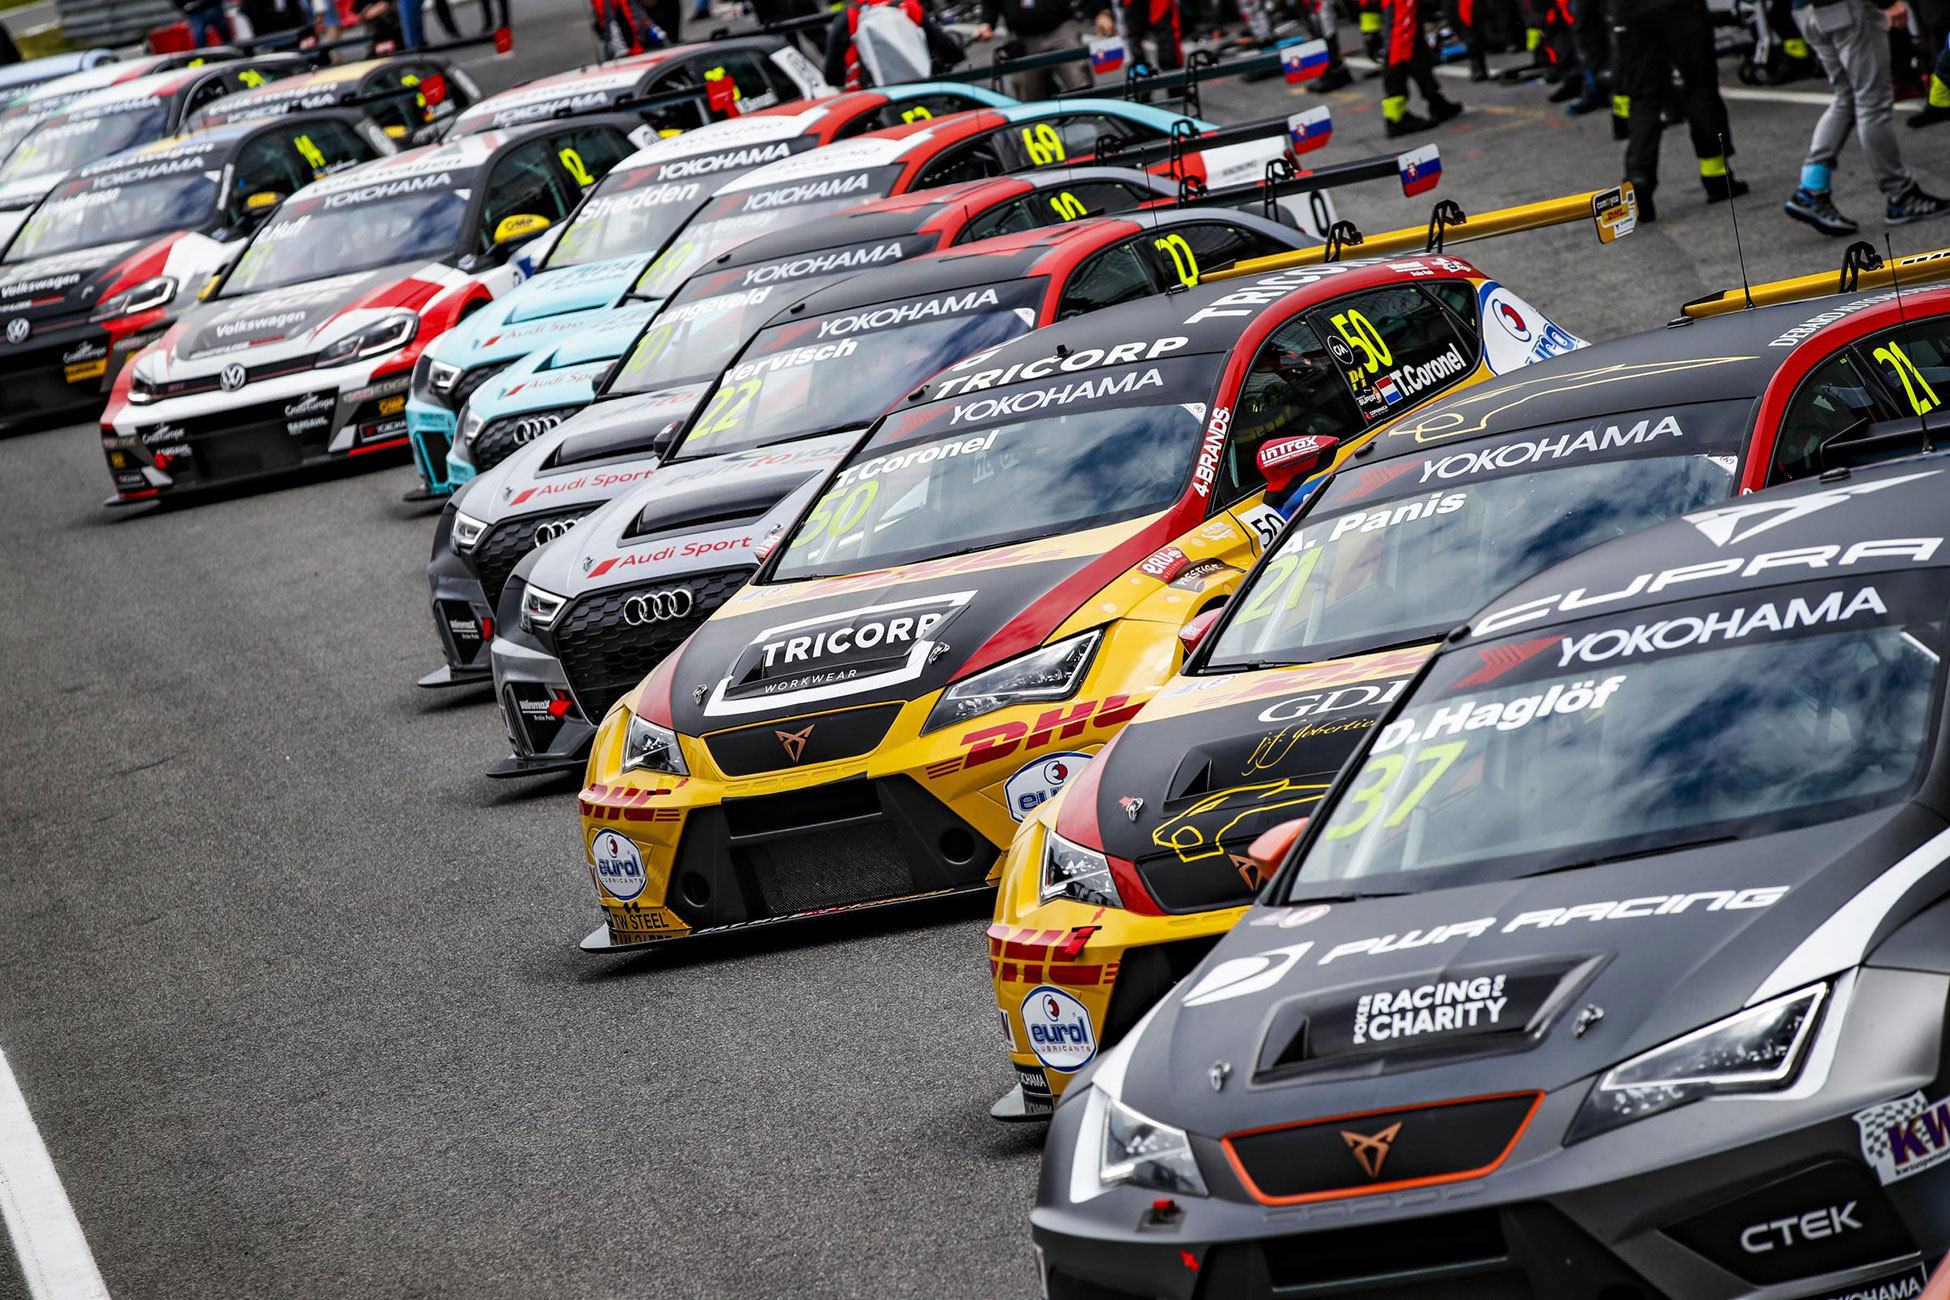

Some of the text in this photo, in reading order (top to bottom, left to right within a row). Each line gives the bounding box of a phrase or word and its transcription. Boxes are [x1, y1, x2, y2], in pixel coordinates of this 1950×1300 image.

[657, 142, 791, 181] YOKOHAMA
[1021, 124, 1066, 166] 69
[93, 156, 204, 189] YOKOHAMA
[323, 172, 451, 209] YOKOHAMA
[742, 173, 869, 212] YOKOHAMA
[575, 183, 700, 223] Shedden
[1, 273, 80, 298] Volkswagen
[742, 243, 903, 286] YOKOHAMA
[216, 310, 307, 338] Volkswagen
[648, 286, 773, 333] Langeveld
[816, 289, 999, 339] YOKOHAMA
[721, 337, 858, 388] Vervisch
[1330, 308, 1393, 373] 50
[932, 336, 1189, 400] TRICORP
[1393, 343, 1467, 397] T.Coronel
[1873, 340, 1942, 417] 21
[685, 379, 763, 443] 22
[949, 368, 1164, 425] YOKOHAMA
[835, 430, 1001, 488] T.Coronel
[1418, 414, 1683, 485] YOKOHAMA
[537, 470, 656, 498] Audi Sport
[791, 480, 879, 549] 50
[1328, 491, 1467, 543] Panis
[617, 546, 676, 569] Audi
[680, 535, 752, 559] Sport
[1234, 545, 1324, 627] 21
[1472, 537, 1944, 637] CUPRA
[762, 612, 945, 668] TRICORP
[1558, 586, 1888, 667] YOKOHAMA
[764, 668, 858, 694] WORKWEAR
[959, 695, 1147, 770] DHL
[1370, 674, 1627, 756] D.Haglöf
[1326, 740, 1468, 840] 37
[598, 853, 641, 878] eurol
[612, 912, 670, 930] TW STEEL
[1318, 885, 1790, 966] PWR RACING
[1368, 996, 1508, 1041] CHARITY
[1370, 976, 1492, 1016] RACING
[1031, 1016, 1089, 1045] eurol
[1740, 1200, 1863, 1254] CTEK
